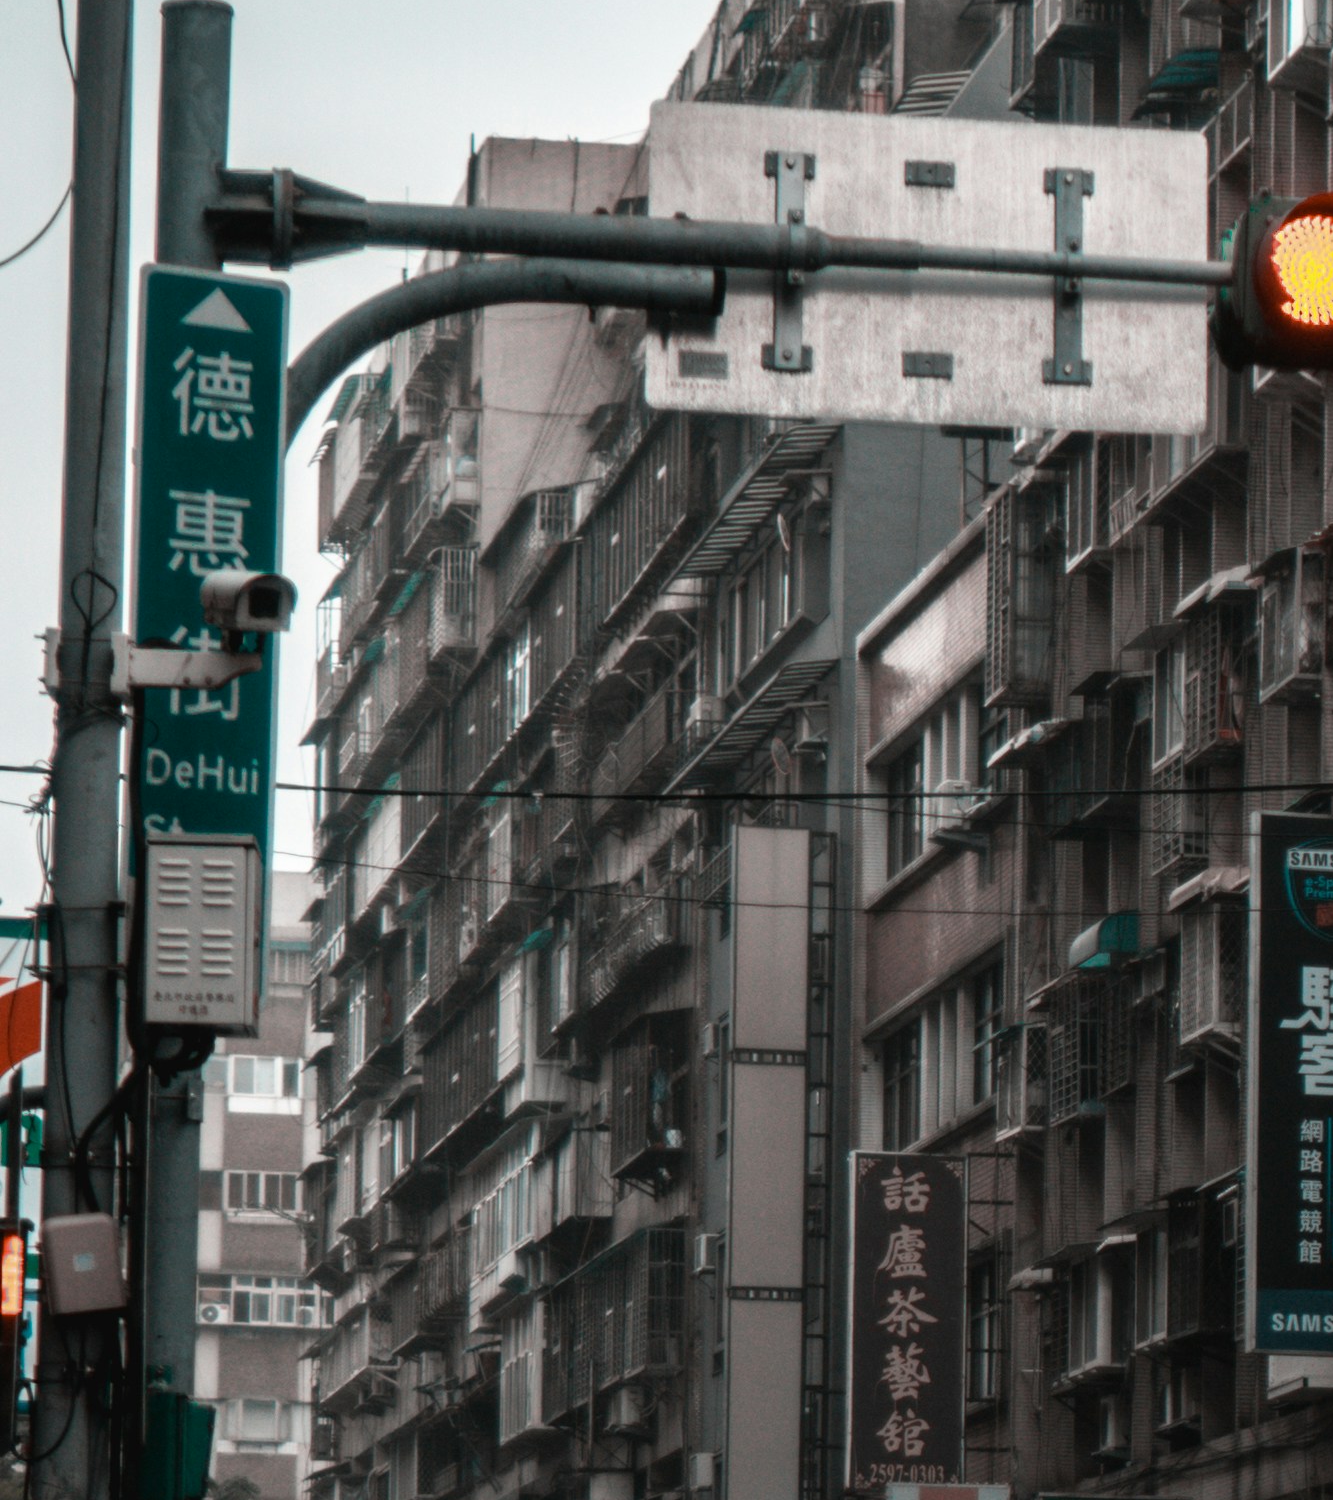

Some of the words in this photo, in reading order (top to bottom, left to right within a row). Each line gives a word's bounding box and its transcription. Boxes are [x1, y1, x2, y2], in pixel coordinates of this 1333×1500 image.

[146, 747, 259, 795] DeHui
[1299, 1118, 1324, 1265] 網路電競館
[869, 1462, 946, 1484] 2597-0303
